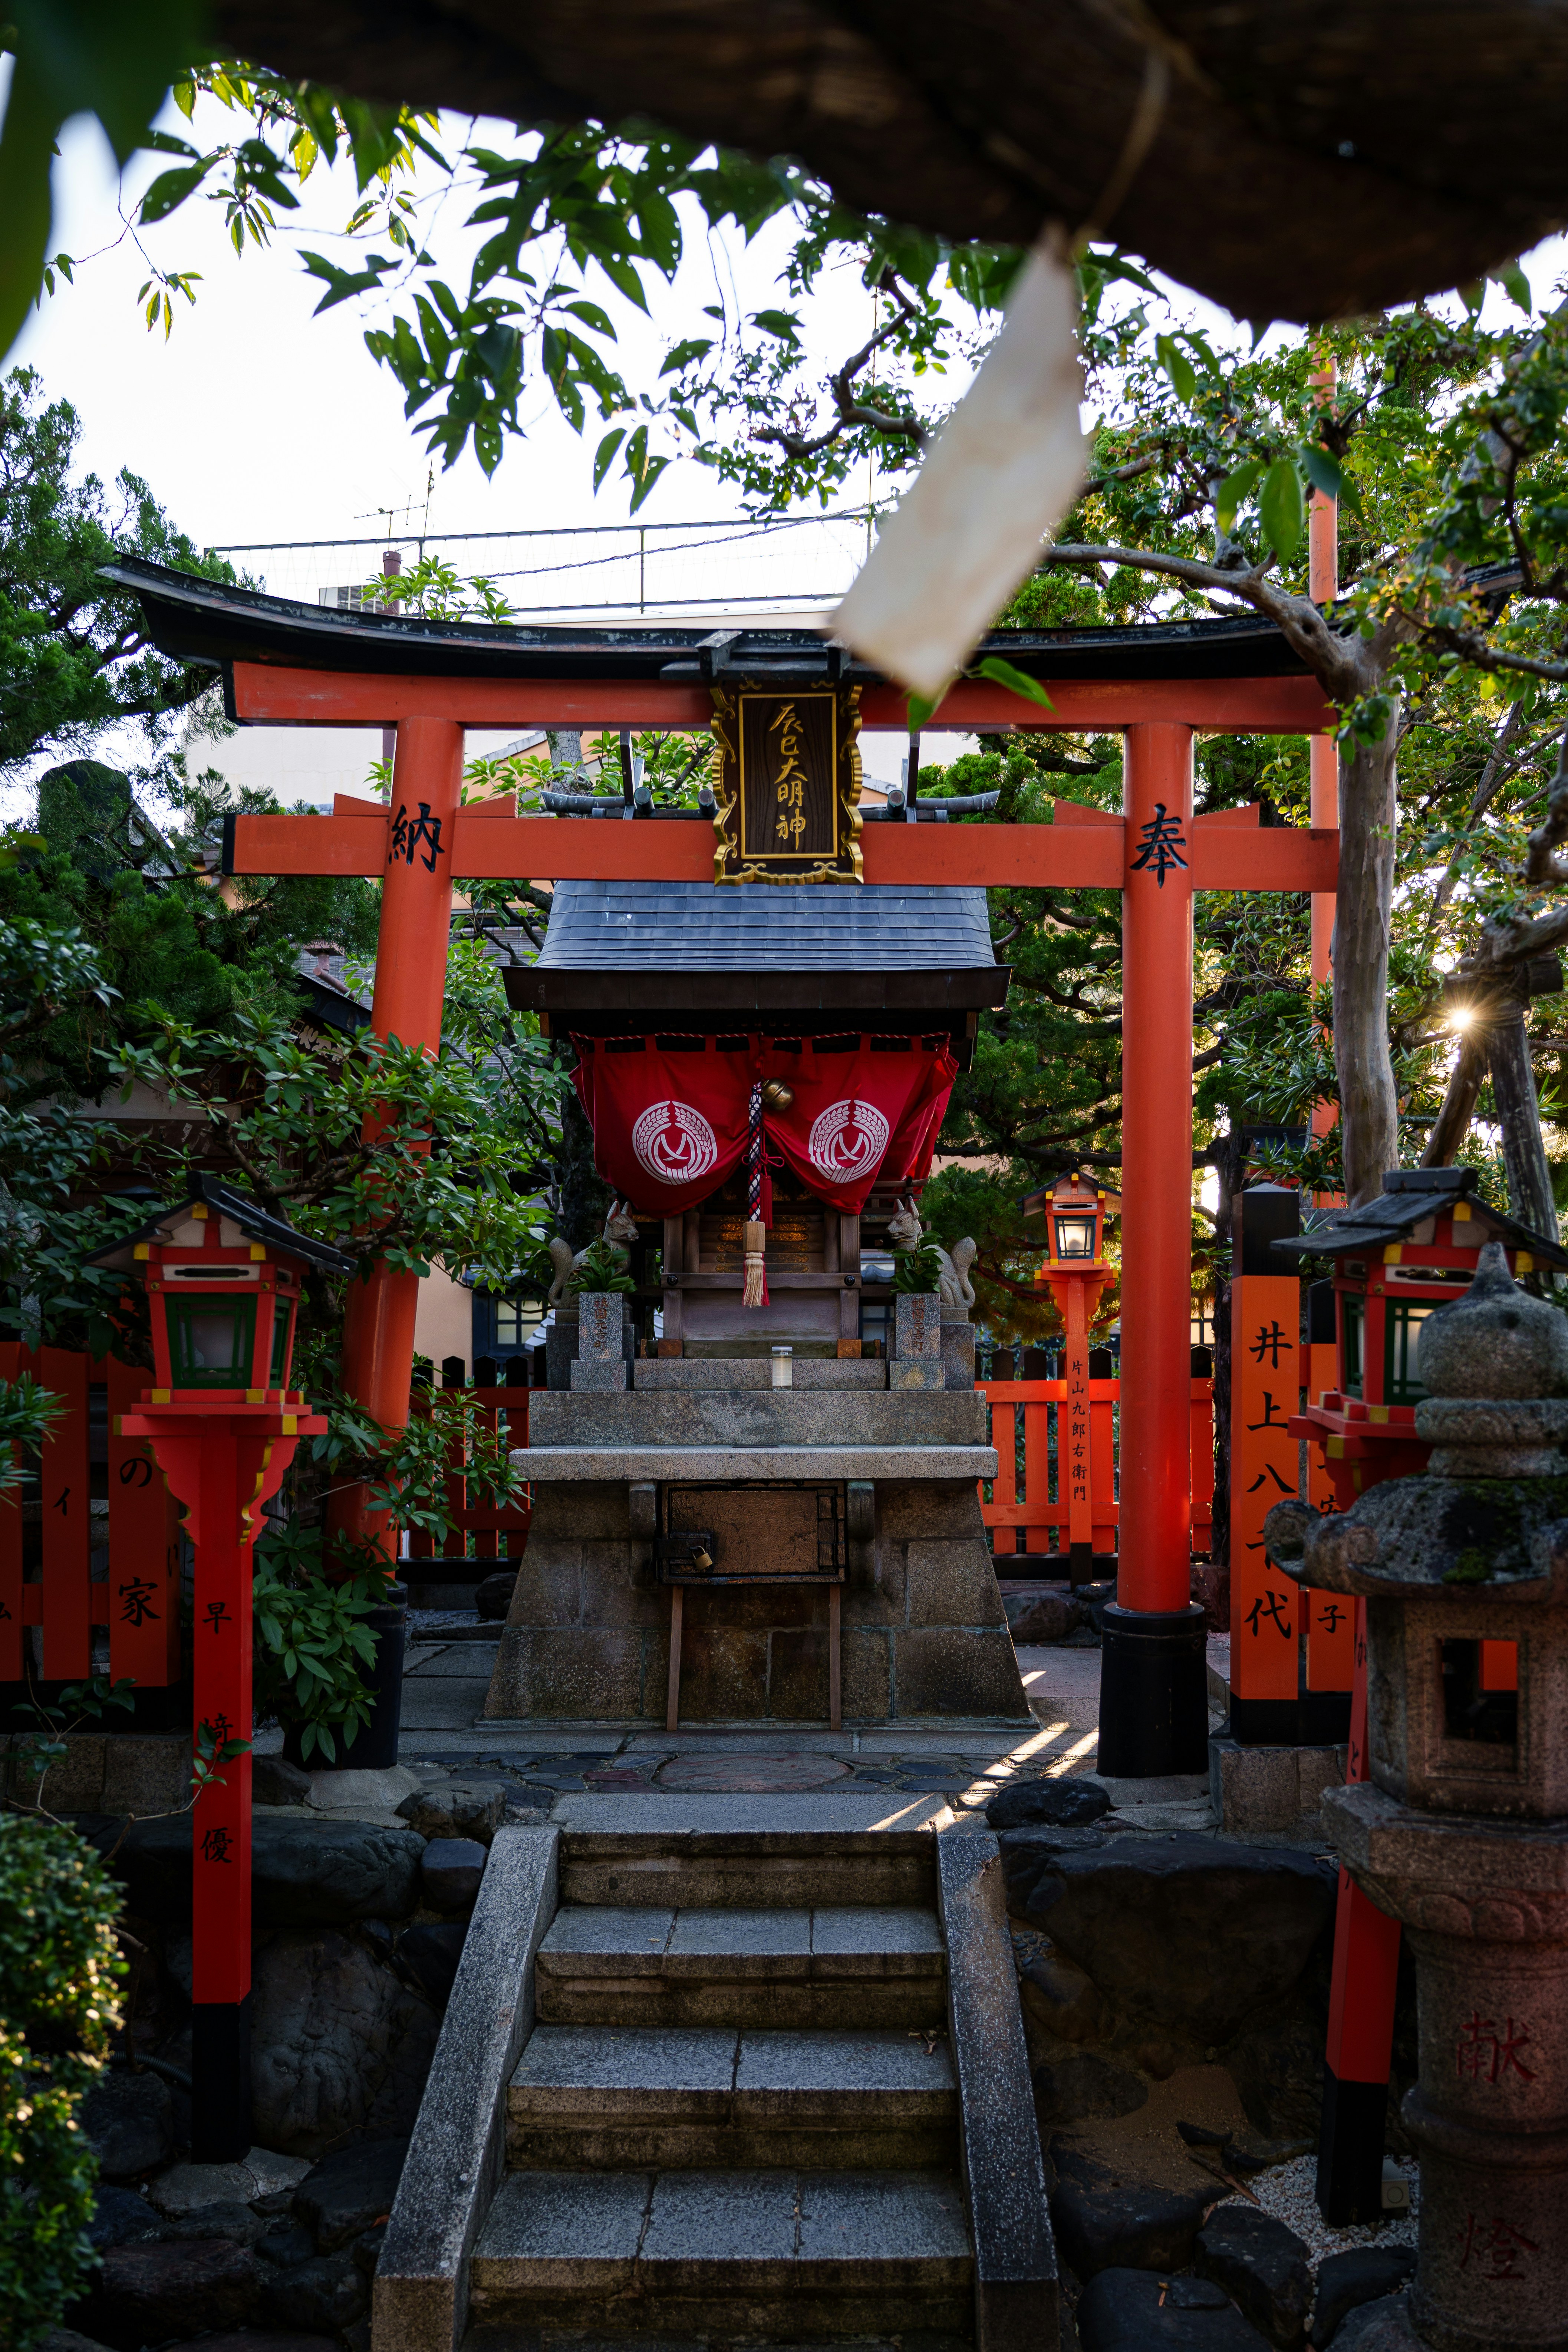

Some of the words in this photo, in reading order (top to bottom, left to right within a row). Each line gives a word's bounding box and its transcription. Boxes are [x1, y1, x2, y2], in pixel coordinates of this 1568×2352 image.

[388, 803, 445, 873] 納
[769, 703, 807, 850] 辰巳大明神
[1129, 803, 1188, 889] 奉
[119, 1327, 161, 1627] の家
[1072, 1360, 1087, 1501] 片山九郎右衛門
